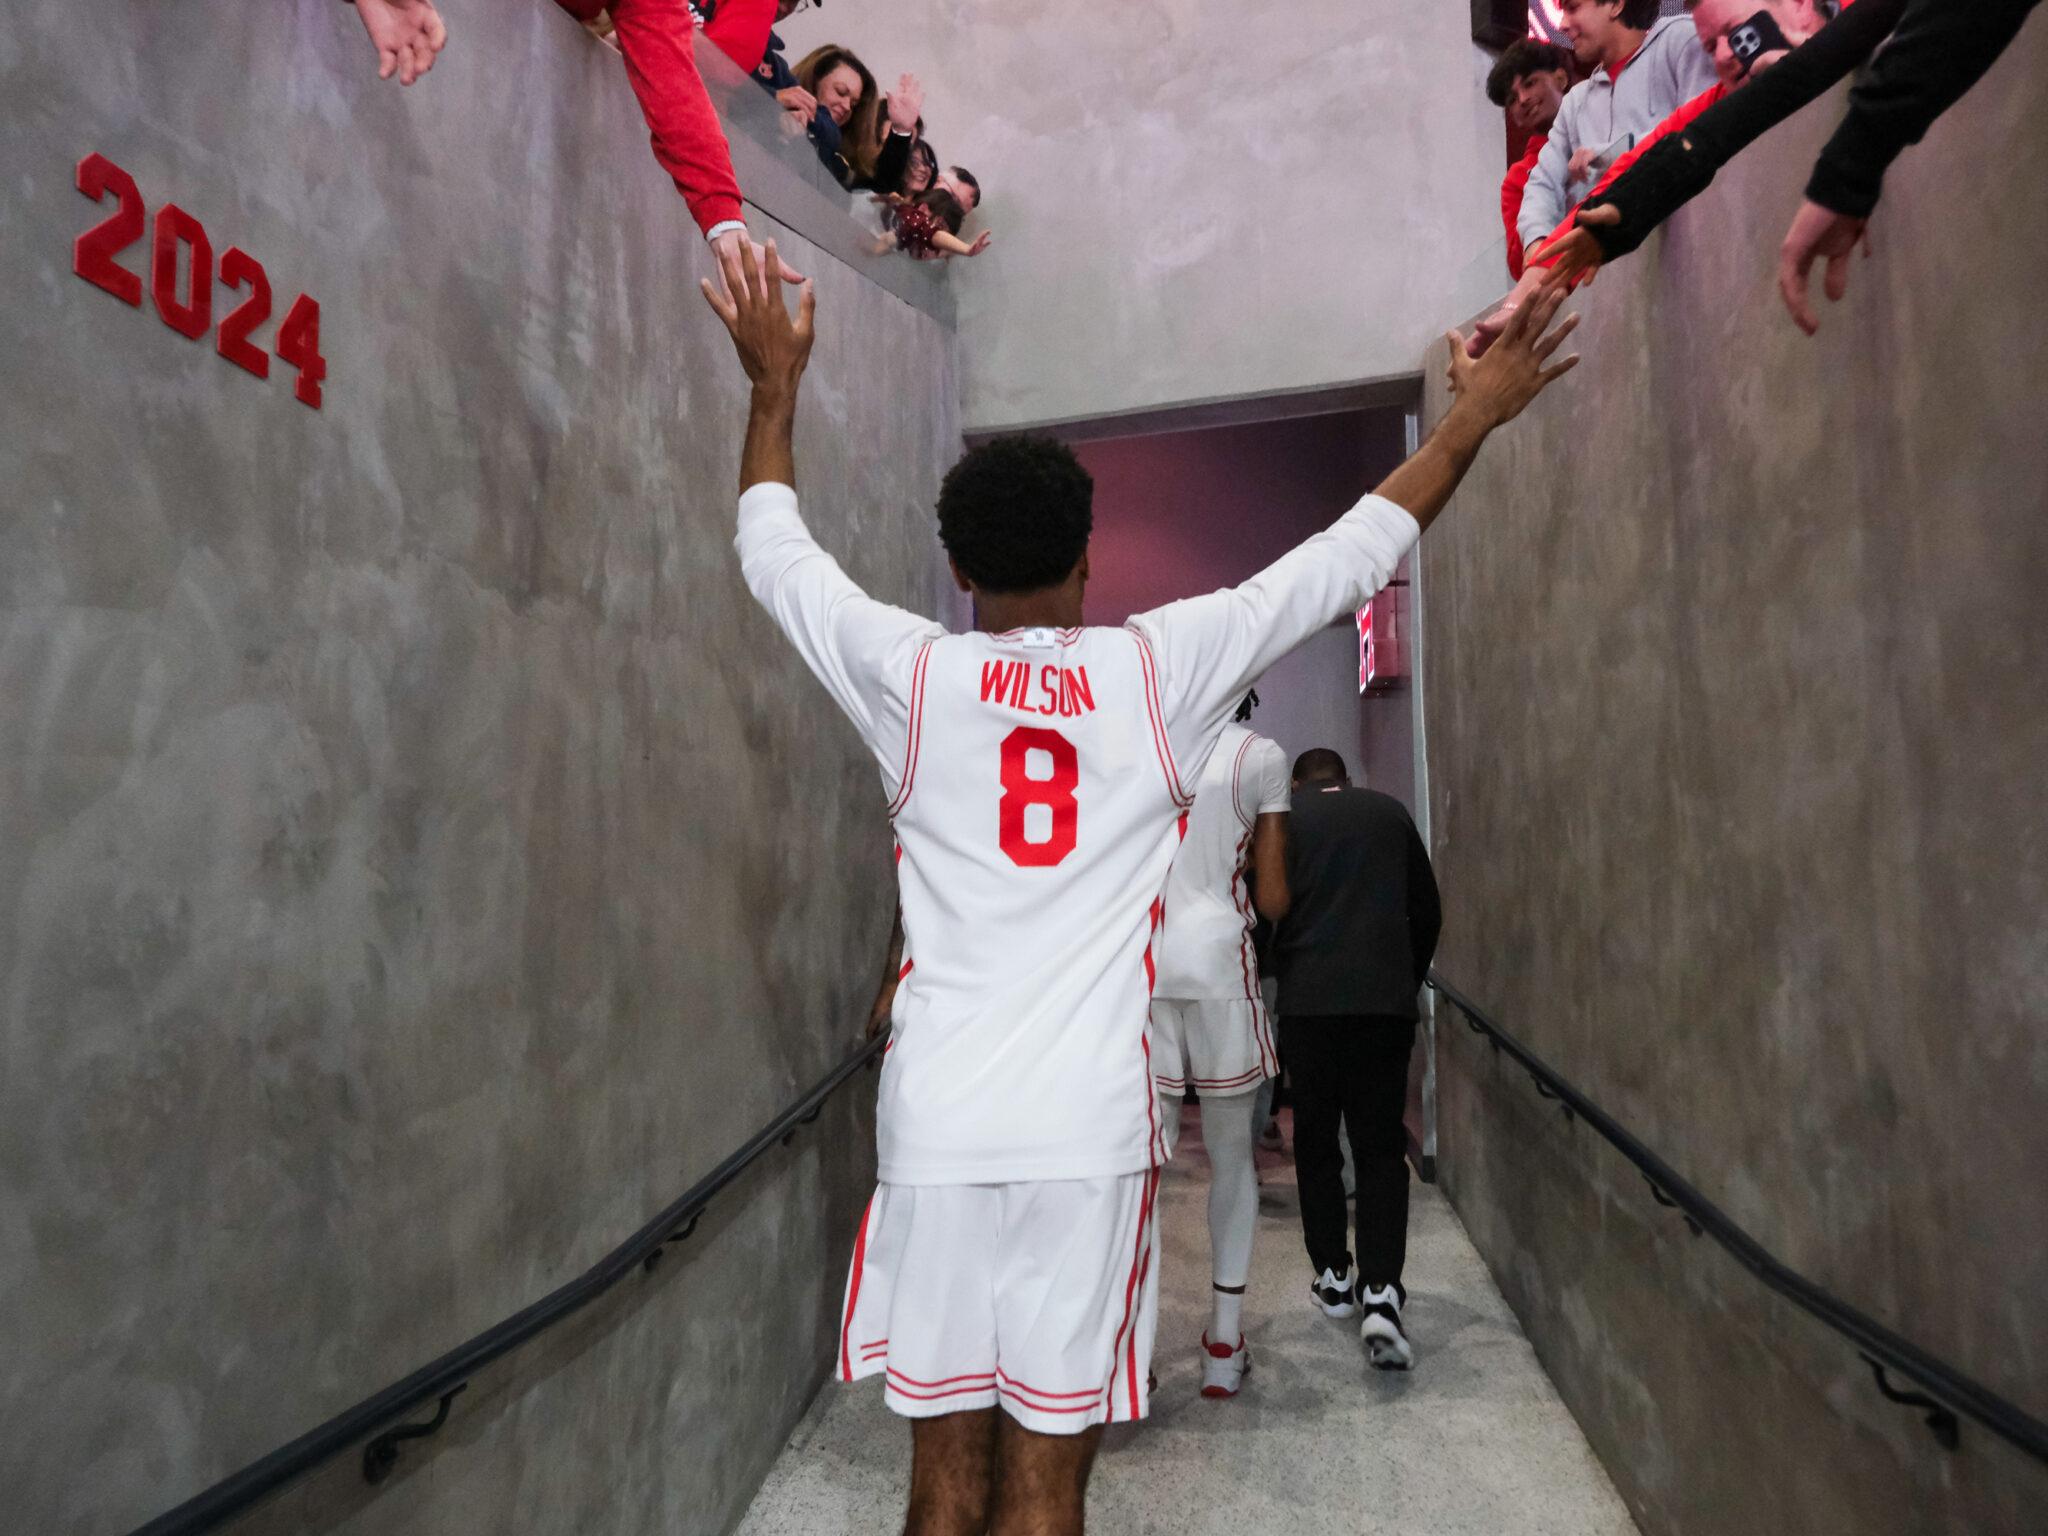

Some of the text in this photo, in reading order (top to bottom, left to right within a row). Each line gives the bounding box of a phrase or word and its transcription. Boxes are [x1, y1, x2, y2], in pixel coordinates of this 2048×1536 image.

[74, 152, 326, 408] 2024
[981, 660, 1096, 717] WILSON
[999, 726, 1079, 867] 8
